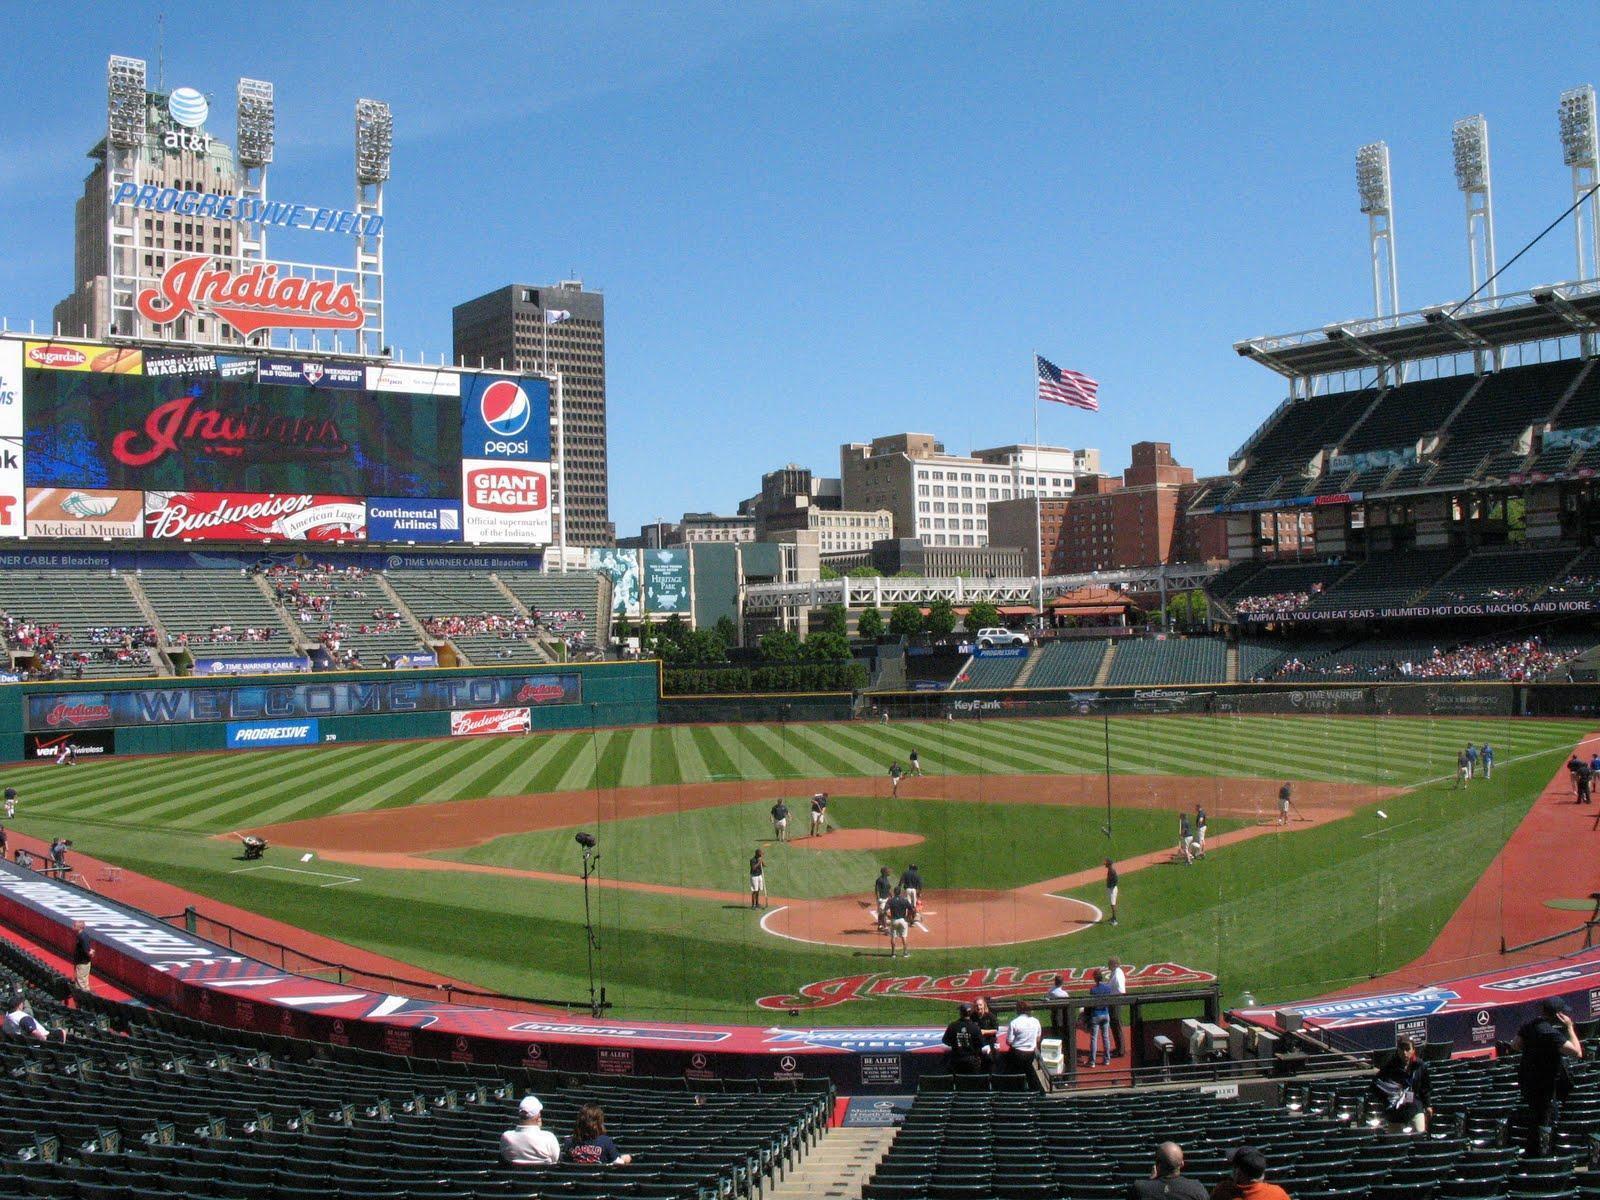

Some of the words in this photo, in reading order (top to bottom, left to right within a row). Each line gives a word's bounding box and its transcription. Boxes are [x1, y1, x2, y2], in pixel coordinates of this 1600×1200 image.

[164, 129, 212, 153] at&t
[114, 182, 303, 228] PROGRESSIVE
[311, 208, 384, 236] FIELD
[137, 256, 365, 332] Indians
[29, 349, 86, 363] Sugardale
[146, 359, 176, 368] MINOR
[147, 361, 217, 376] MAGAZINE
[222, 367, 246, 377] STO
[485, 440, 528, 456] pepsi
[474, 473, 540, 490] GIANT
[476, 489, 538, 505] EAGLE
[146, 494, 313, 538] Budweiser
[290, 510, 333, 532] American
[335, 509, 363, 520] Lager
[370, 508, 437, 519] Continental
[393, 519, 437, 530] Airlines
[467, 517, 497, 526] Official
[500, 517, 548, 527] supermarket
[35, 522, 86, 536] Medical
[91, 524, 136, 537] Mutual
[480, 528, 488, 537] of
[490, 528, 503, 537] the
[505, 528, 537, 537] Indians.
[23, 556, 58, 565] CABLE
[61, 556, 110, 566] Bleachers
[404, 558, 425, 566] TIME
[426, 558, 462, 566] WARNER
[463, 558, 489, 567] CABLE
[491, 558, 528, 567] Bleachers
[1248, 613, 1275, 622] AMPM
[1276, 613, 1290, 621] ALL
[1292, 612, 1310, 620] YOU
[1312, 611, 1330, 619] CAN
[1332, 610, 1347, 618] EAT
[1349, 609, 1374, 618] SEATS
[1381, 606, 1429, 617] UNLIMITED
[1432, 606, 1451, 615] HOT
[1454, 605, 1484, 615] DOGS,
[1486, 603, 1531, 614] NACHOS,
[1533, 602, 1557, 612] AND
[1559, 601, 1590, 611] MORE
[243, 662, 272, 670] WARNER
[272, 661, 293, 669] CABLE
[139, 680, 416, 723] WELCOME
[440, 678, 500, 707] TO
[1134, 689, 1188, 699] FirstEnergy
[1305, 690, 1325, 699] TIME
[1326, 690, 1363, 700] WARNER
[954, 700, 1001, 711] KeyBank
[47, 703, 112, 725] Indians
[454, 709, 521, 734] Budweiser
[236, 725, 311, 742] PROGRESSIVE
[94, 928, 213, 955] FIELD
[756, 961, 1219, 1012] Indians
[1354, 1005, 1426, 1018] FIELD
[524, 1023, 637, 1036] Indians
[1407, 1020, 1424, 1029] ALERT
[610, 1051, 630, 1059] ALERT
